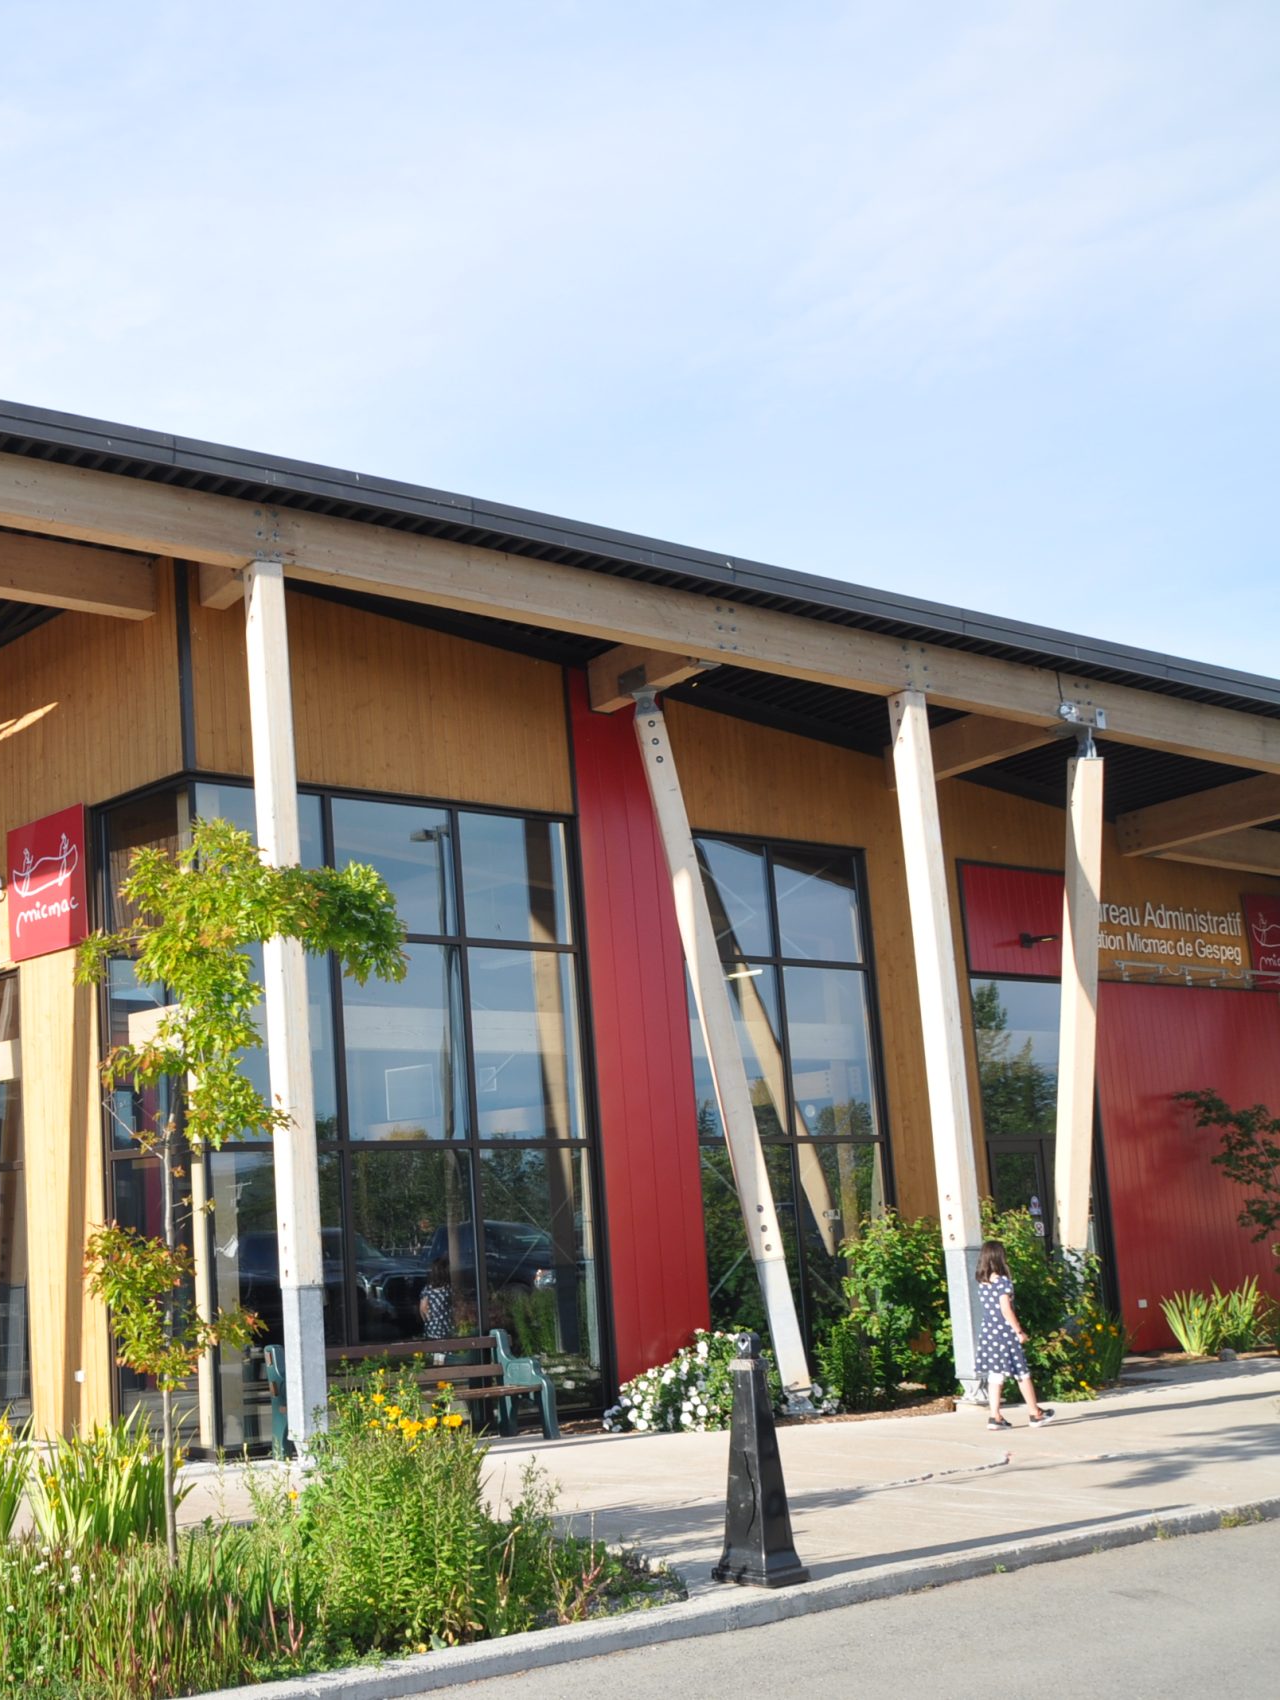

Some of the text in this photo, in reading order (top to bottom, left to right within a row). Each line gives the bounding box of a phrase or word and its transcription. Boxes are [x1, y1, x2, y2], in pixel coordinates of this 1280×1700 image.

[15, 896, 79, 938] micmac
[1144, 901, 1242, 937] Administratif
[1126, 931, 1175, 955] Micmac
[1177, 937, 1193, 957] de
[1195, 938, 1242, 966] Gespeg
